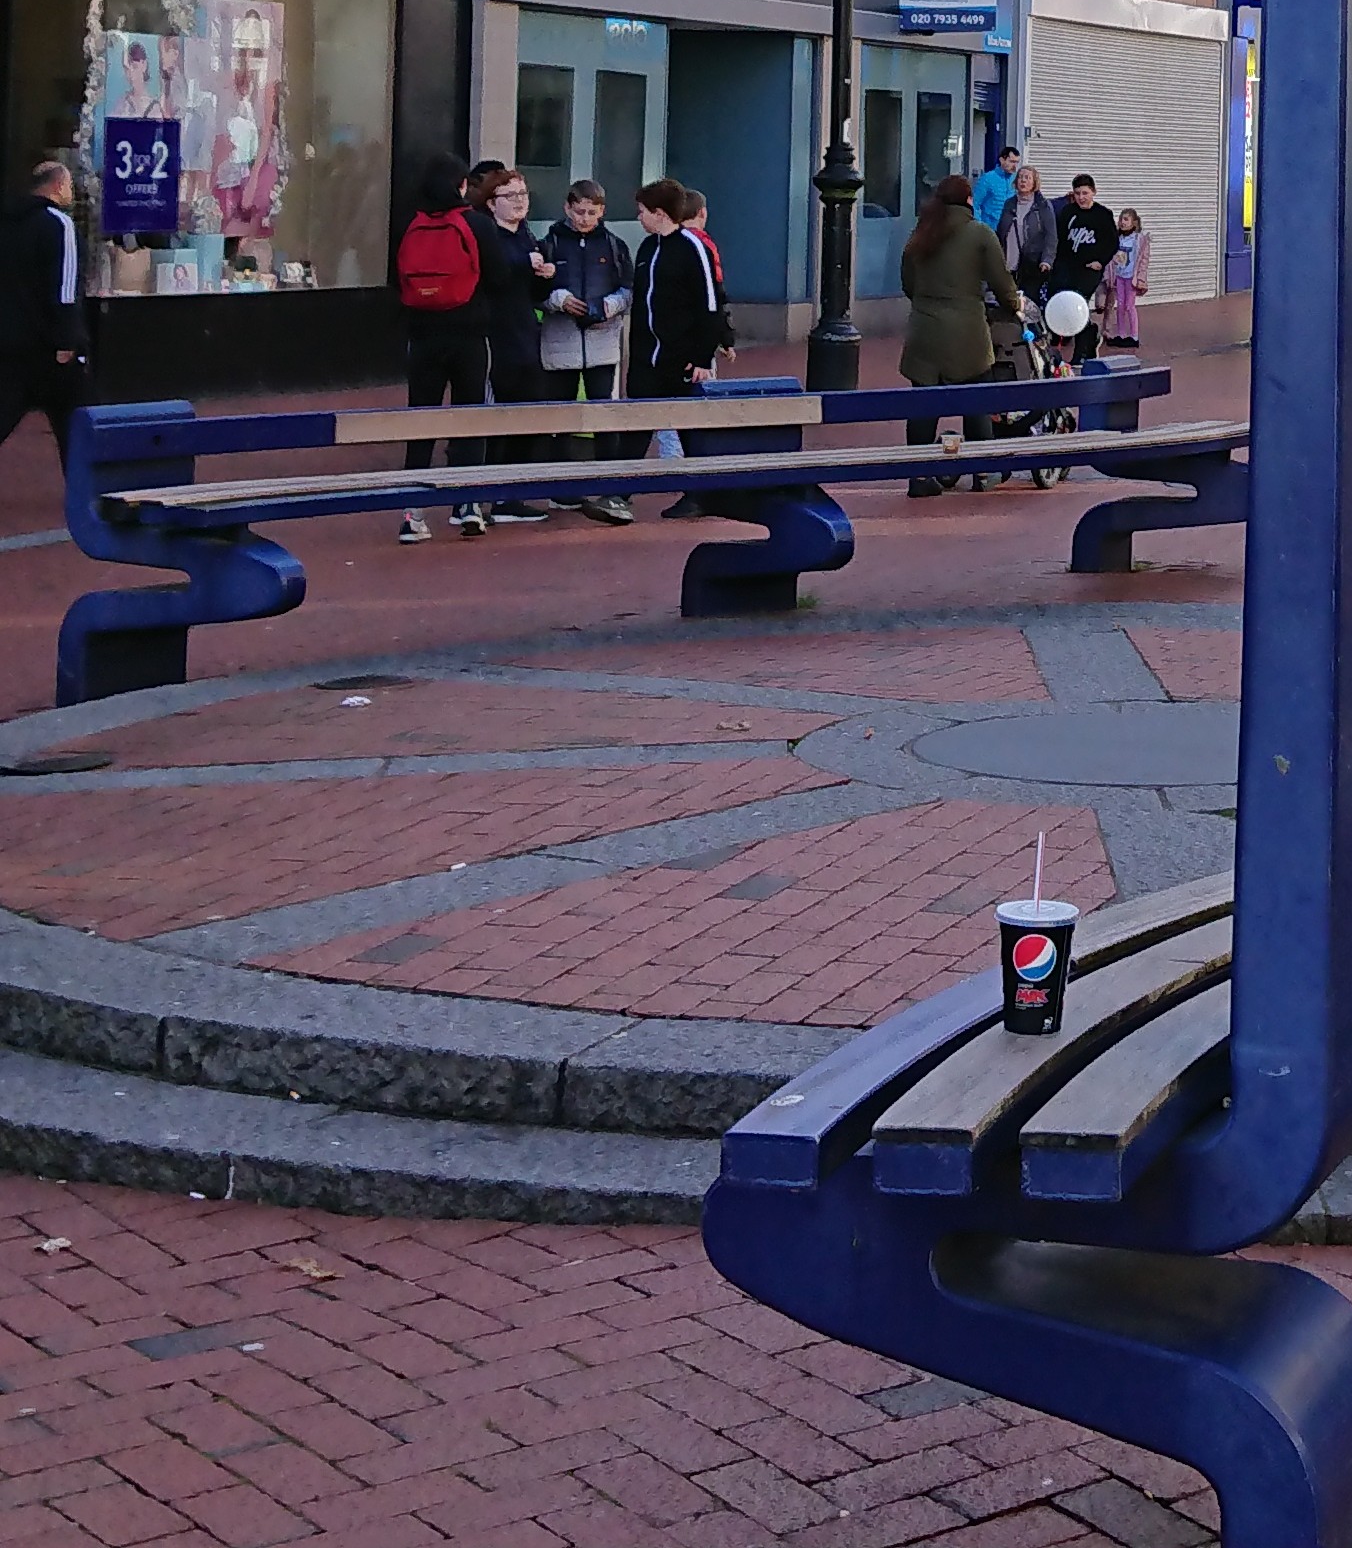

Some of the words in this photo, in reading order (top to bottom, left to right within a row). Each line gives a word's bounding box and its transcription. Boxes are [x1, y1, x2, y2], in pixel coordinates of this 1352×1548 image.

[911, 13, 931, 24] 020
[933, 14, 958, 24] 7935
[960, 15, 985, 25] 4499
[115, 140, 133, 179] 3
[150, 140, 169, 179] 2
